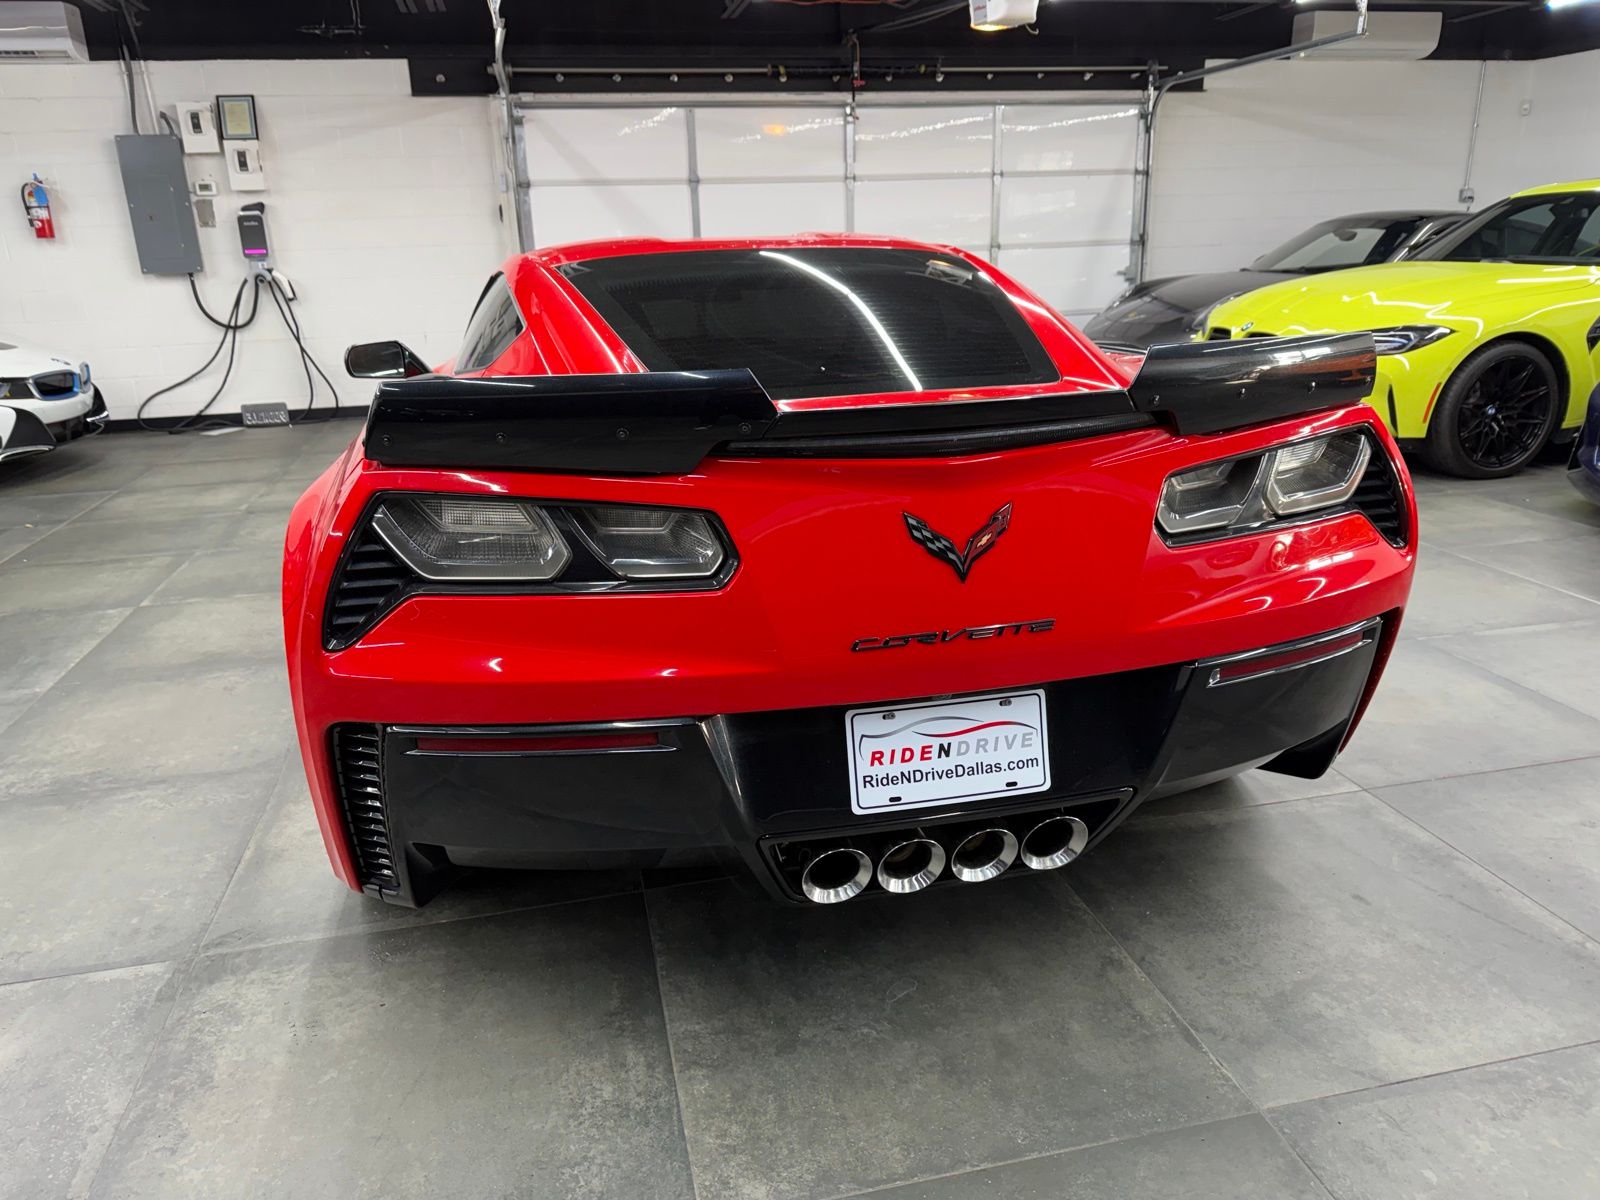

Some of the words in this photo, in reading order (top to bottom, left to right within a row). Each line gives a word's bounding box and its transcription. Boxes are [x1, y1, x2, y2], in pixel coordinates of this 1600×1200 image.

[851, 618, 1055, 651] CORVETTE
[870, 732, 1033, 767] RIDENDRIVE
[863, 757, 1039, 788] RideNDriveDallas.com
